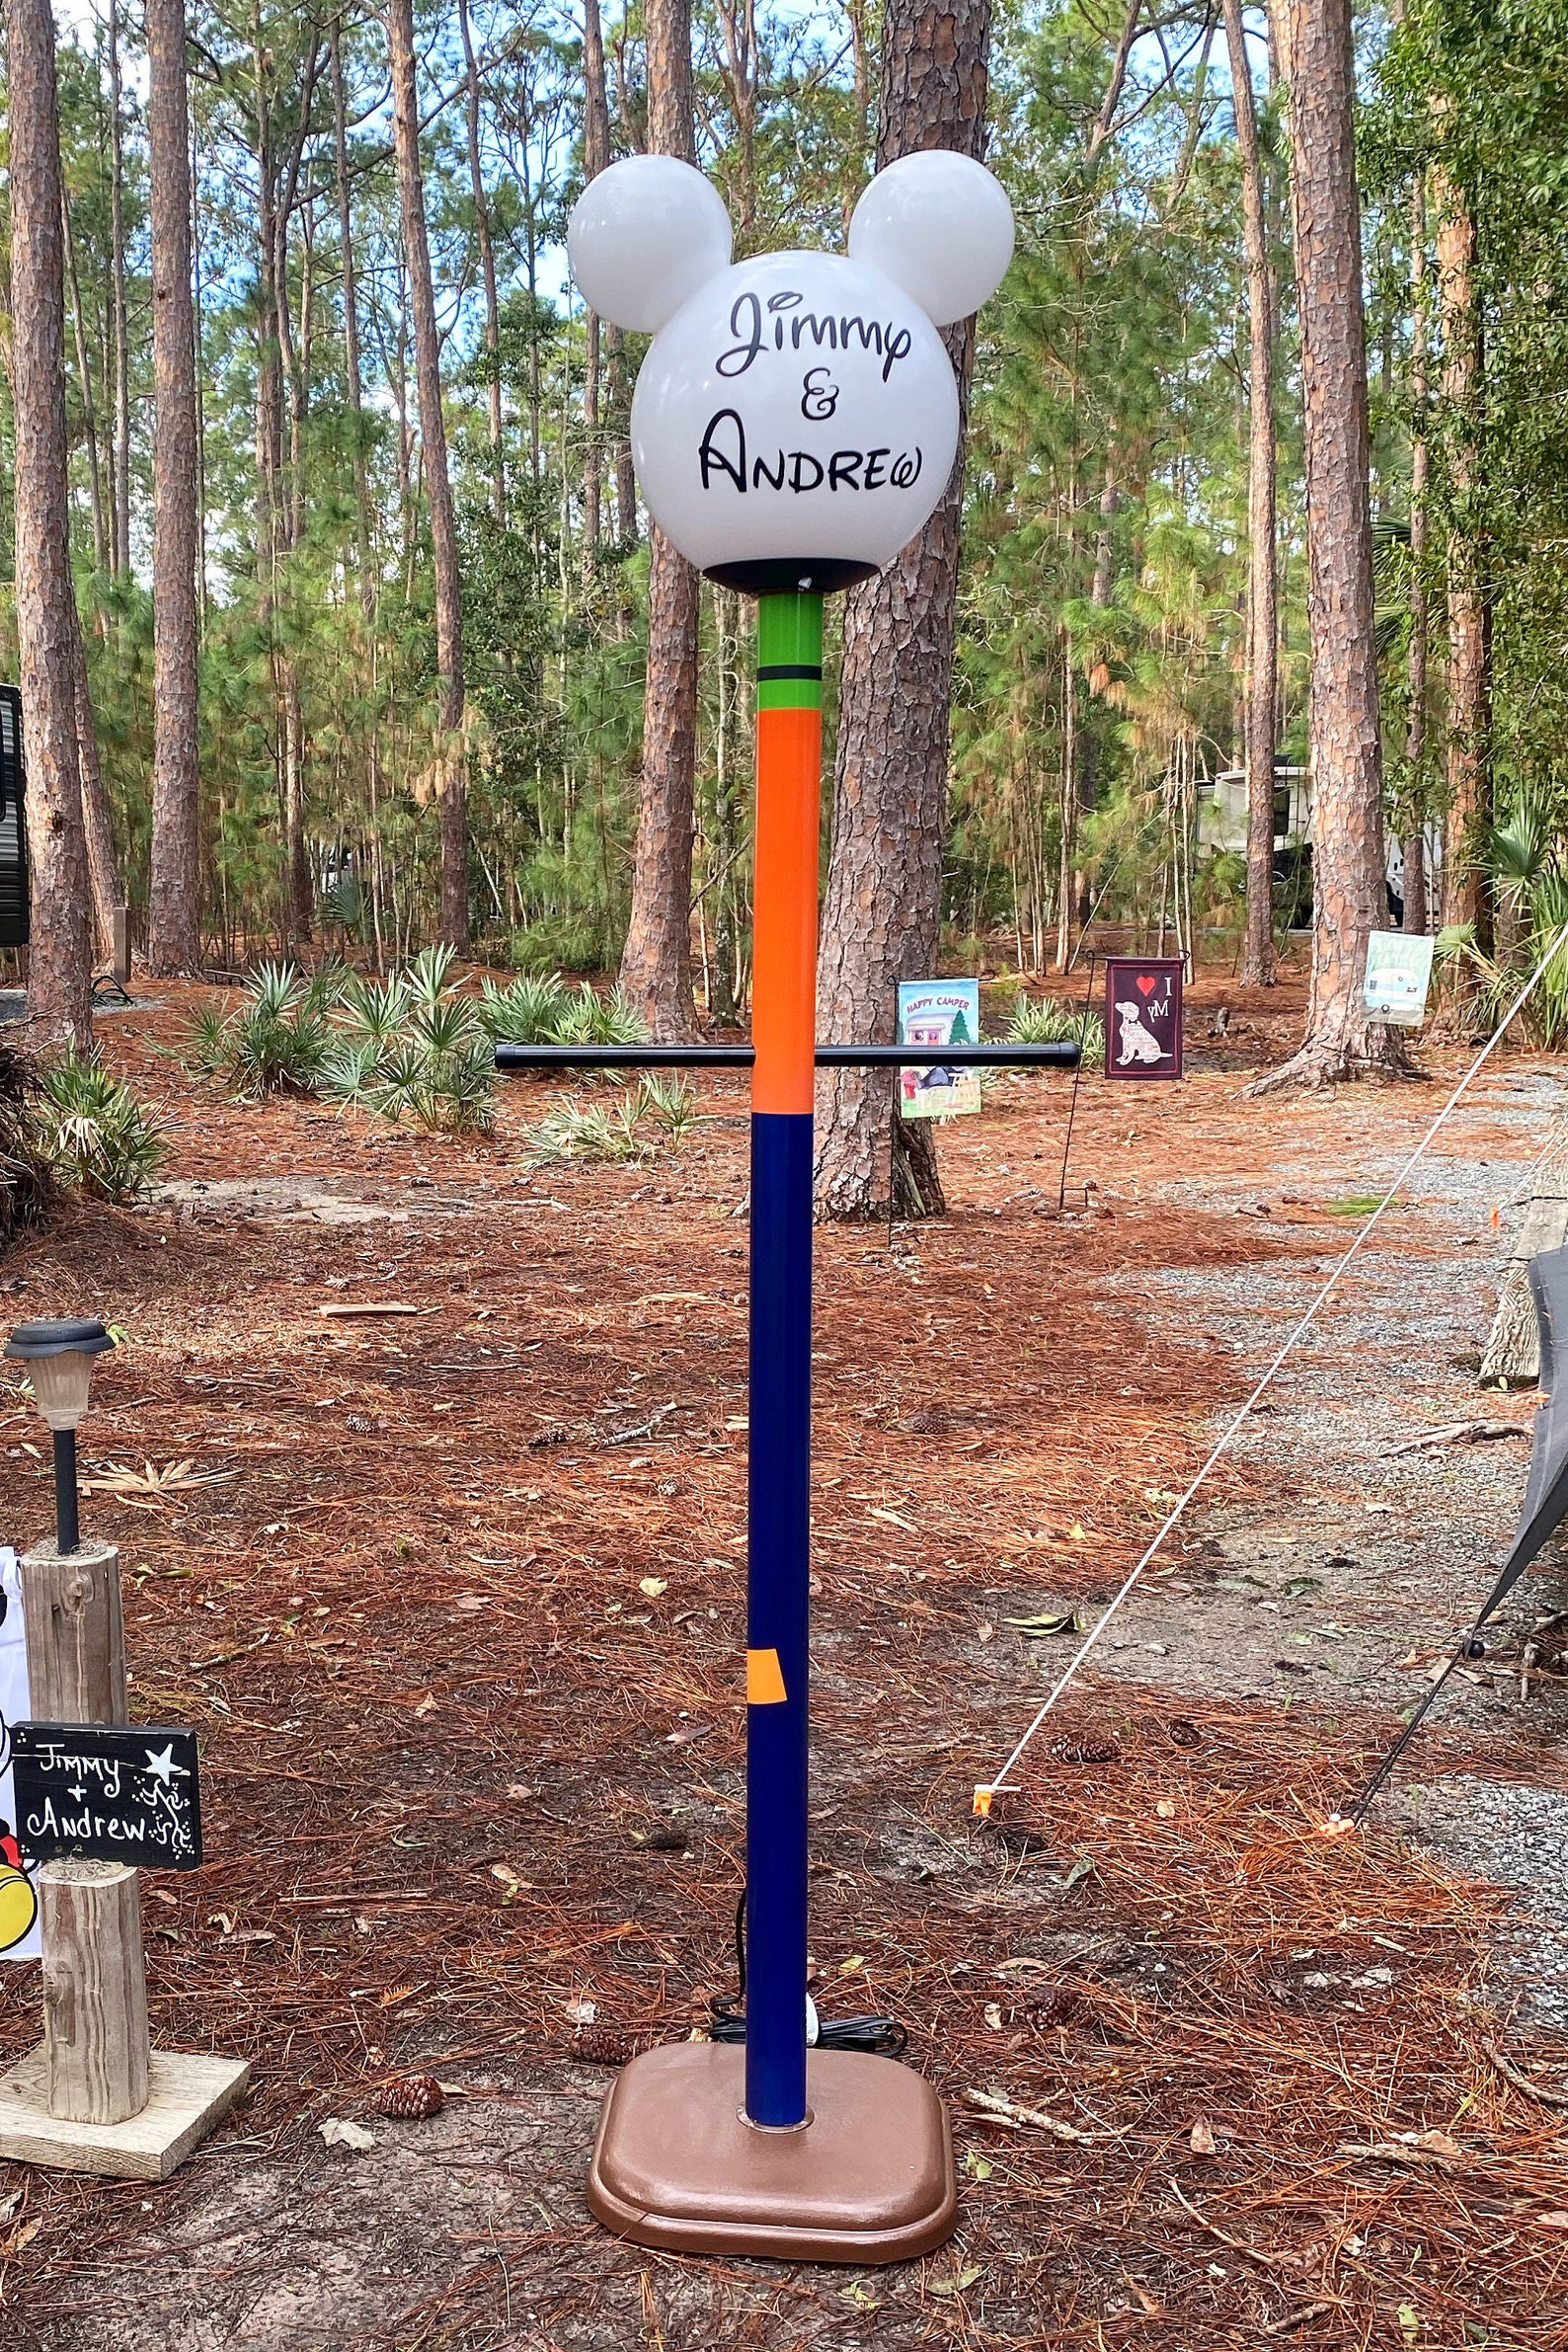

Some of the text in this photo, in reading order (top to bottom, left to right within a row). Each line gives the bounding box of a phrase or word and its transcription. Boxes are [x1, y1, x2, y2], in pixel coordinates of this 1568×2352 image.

[715, 290, 912, 383] Jimmy
[800, 367, 839, 421] &
[906, 996, 970, 1014] HAPPY CAMPER
[67, 1784, 88, 1802] +
